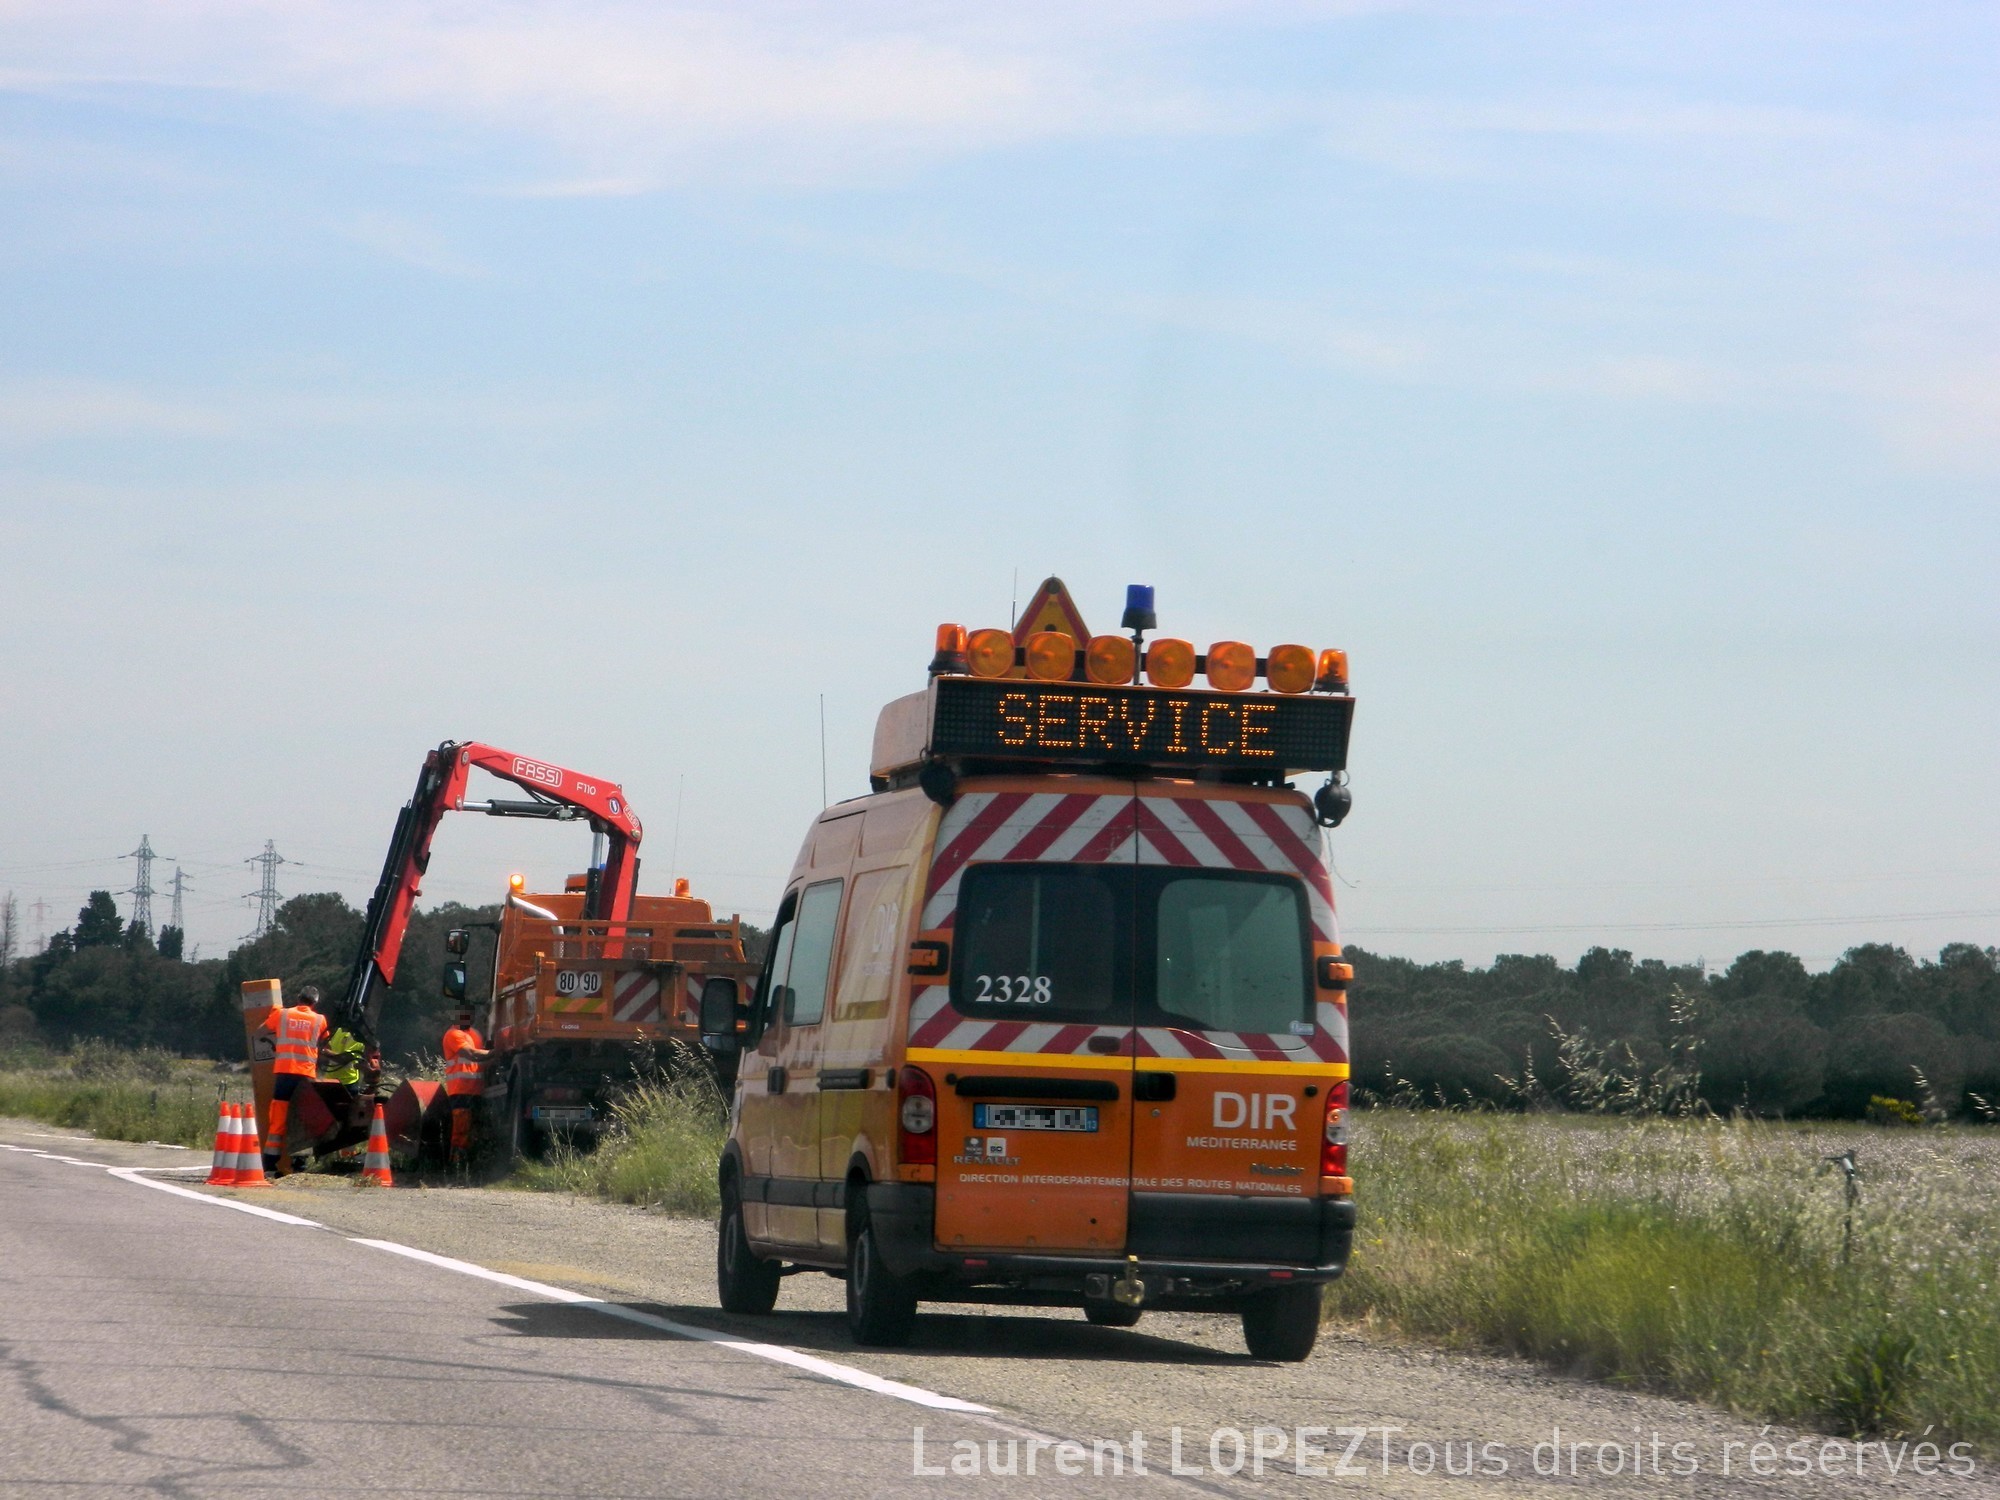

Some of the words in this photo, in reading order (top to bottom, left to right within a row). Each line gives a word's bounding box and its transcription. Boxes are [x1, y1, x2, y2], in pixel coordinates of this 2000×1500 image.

[998, 694, 1276, 755] SERVICE
[516, 760, 559, 784] FASSI
[576, 782, 597, 796] F110
[560, 972, 574, 990] 80
[583, 973, 598, 991] 90
[975, 974, 1052, 1004] 2328
[289, 1018, 311, 1030] DIR
[1213, 1091, 1297, 1130] DIR
[1186, 1136, 1297, 1151] MEDITERRANEE
[953, 1155, 1021, 1166] RENAULT
[959, 1173, 1018, 1183] DIRECTION
[1161, 1178, 1184, 1187] DES
[1187, 1178, 1232, 1189] ROUTES
[1235, 1181, 1302, 1193] NATIONALES
